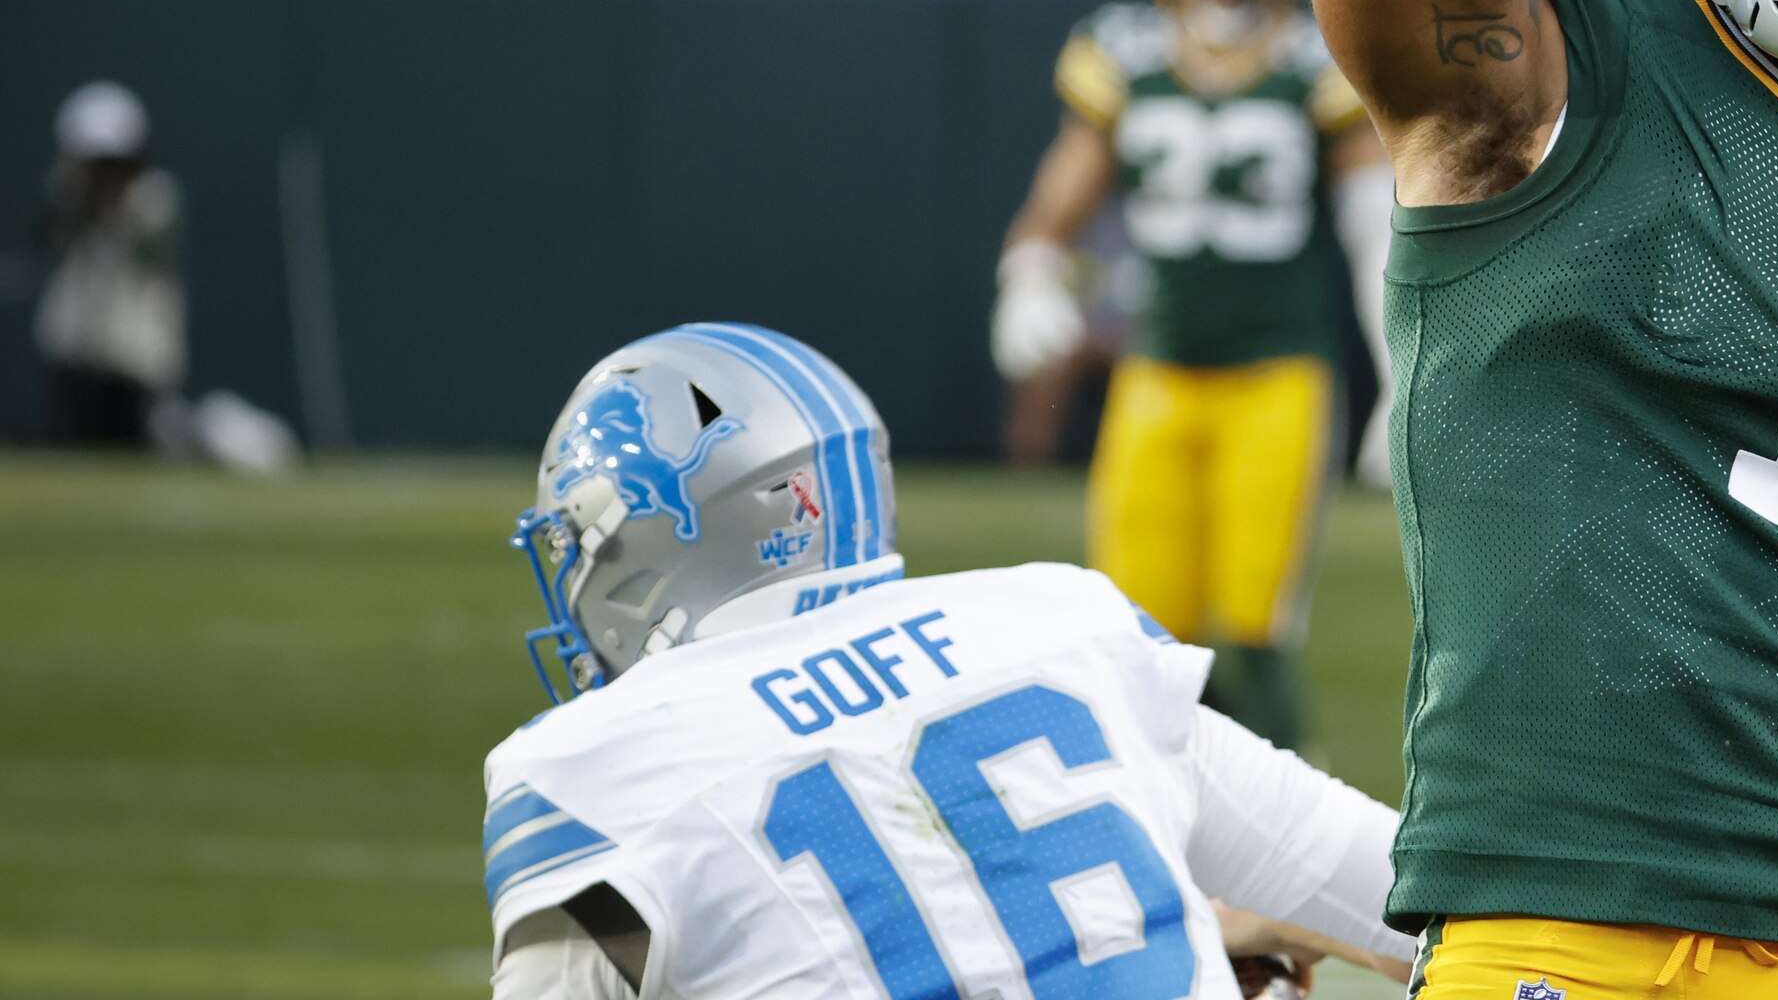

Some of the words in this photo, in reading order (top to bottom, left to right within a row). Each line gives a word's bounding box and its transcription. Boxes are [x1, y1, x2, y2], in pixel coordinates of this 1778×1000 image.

[1112, 100, 1317, 263] 33
[751, 609, 959, 736] GOFF
[753, 676, 1202, 1000] 16
